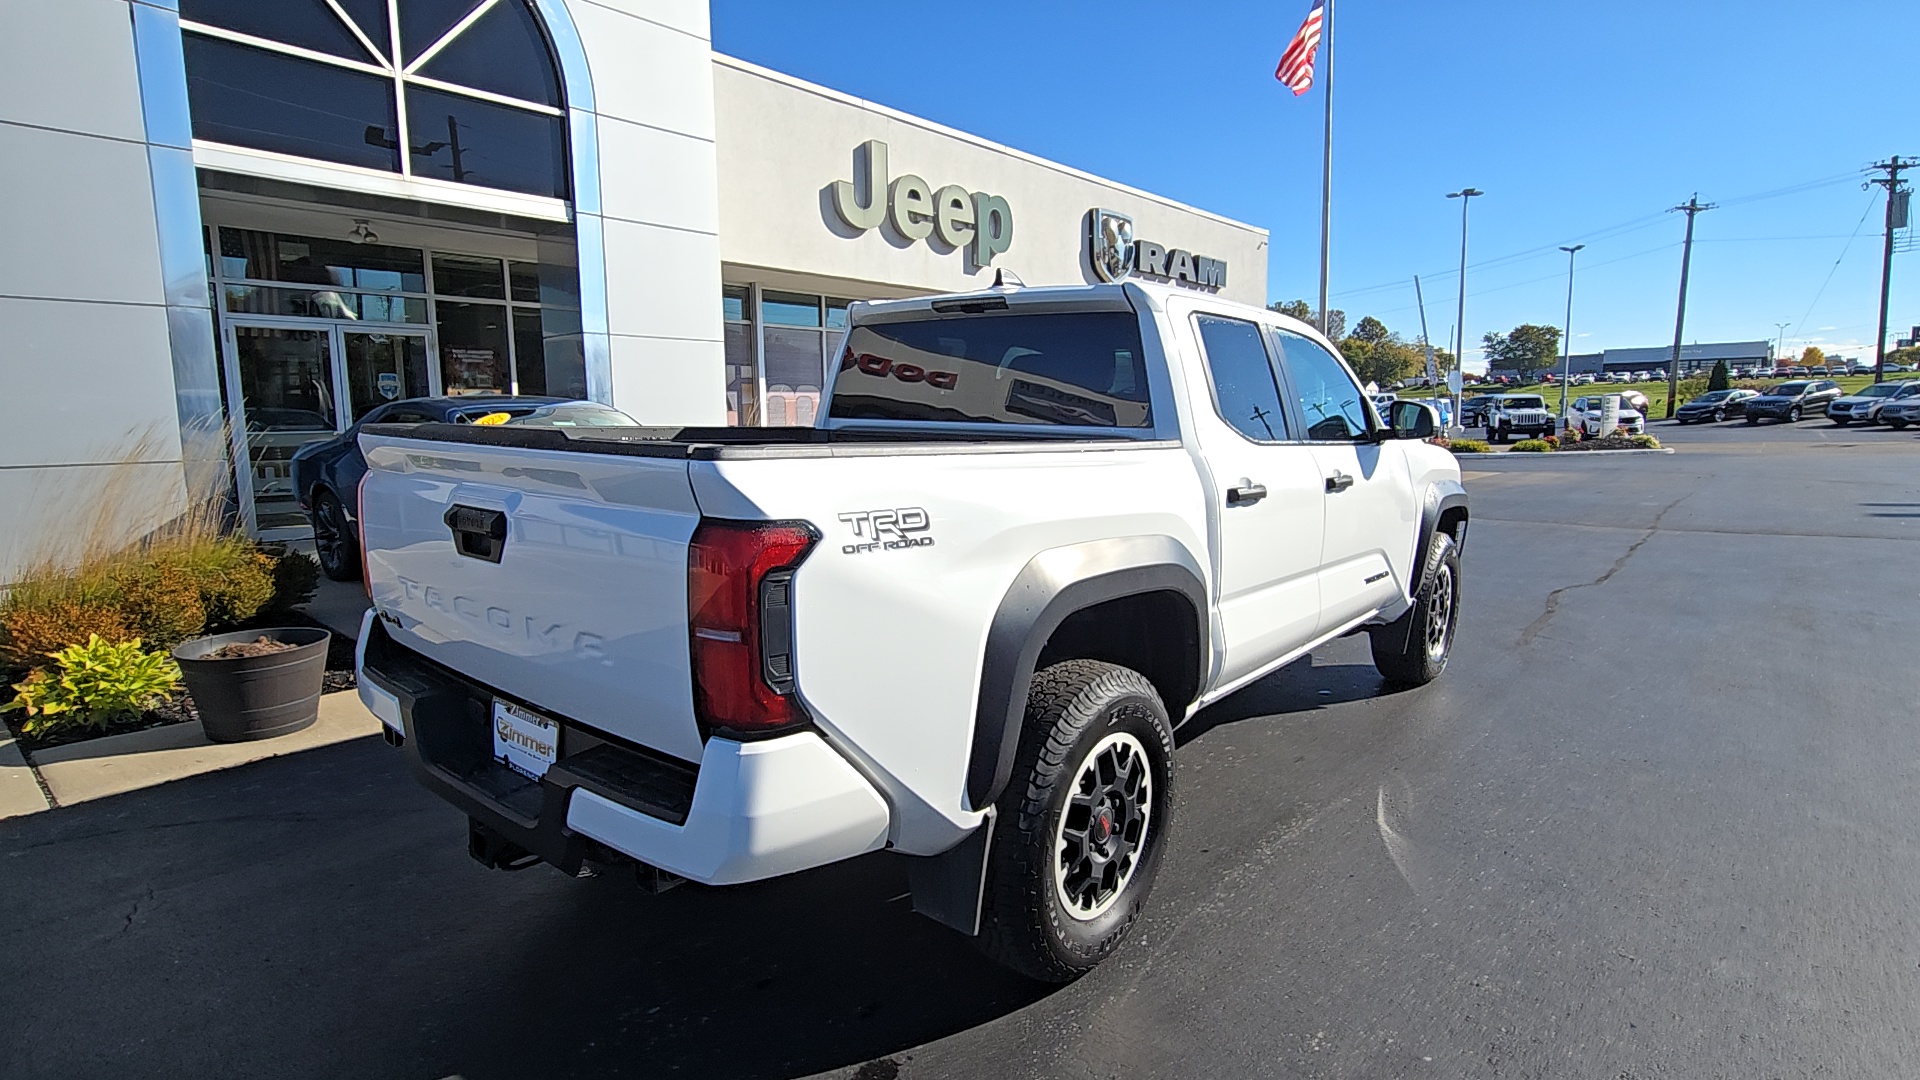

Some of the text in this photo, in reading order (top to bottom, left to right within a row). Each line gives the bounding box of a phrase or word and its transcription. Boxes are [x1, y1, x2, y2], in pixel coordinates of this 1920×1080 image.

[822, 139, 1013, 269] Jeep
[1133, 239, 1228, 289] RAM
[838, 507, 931, 542] TRD
[842, 537, 935, 555] OFF ROAD
[510, 703, 541, 726] Zimmer
[497, 719, 556, 758] Zimmer
